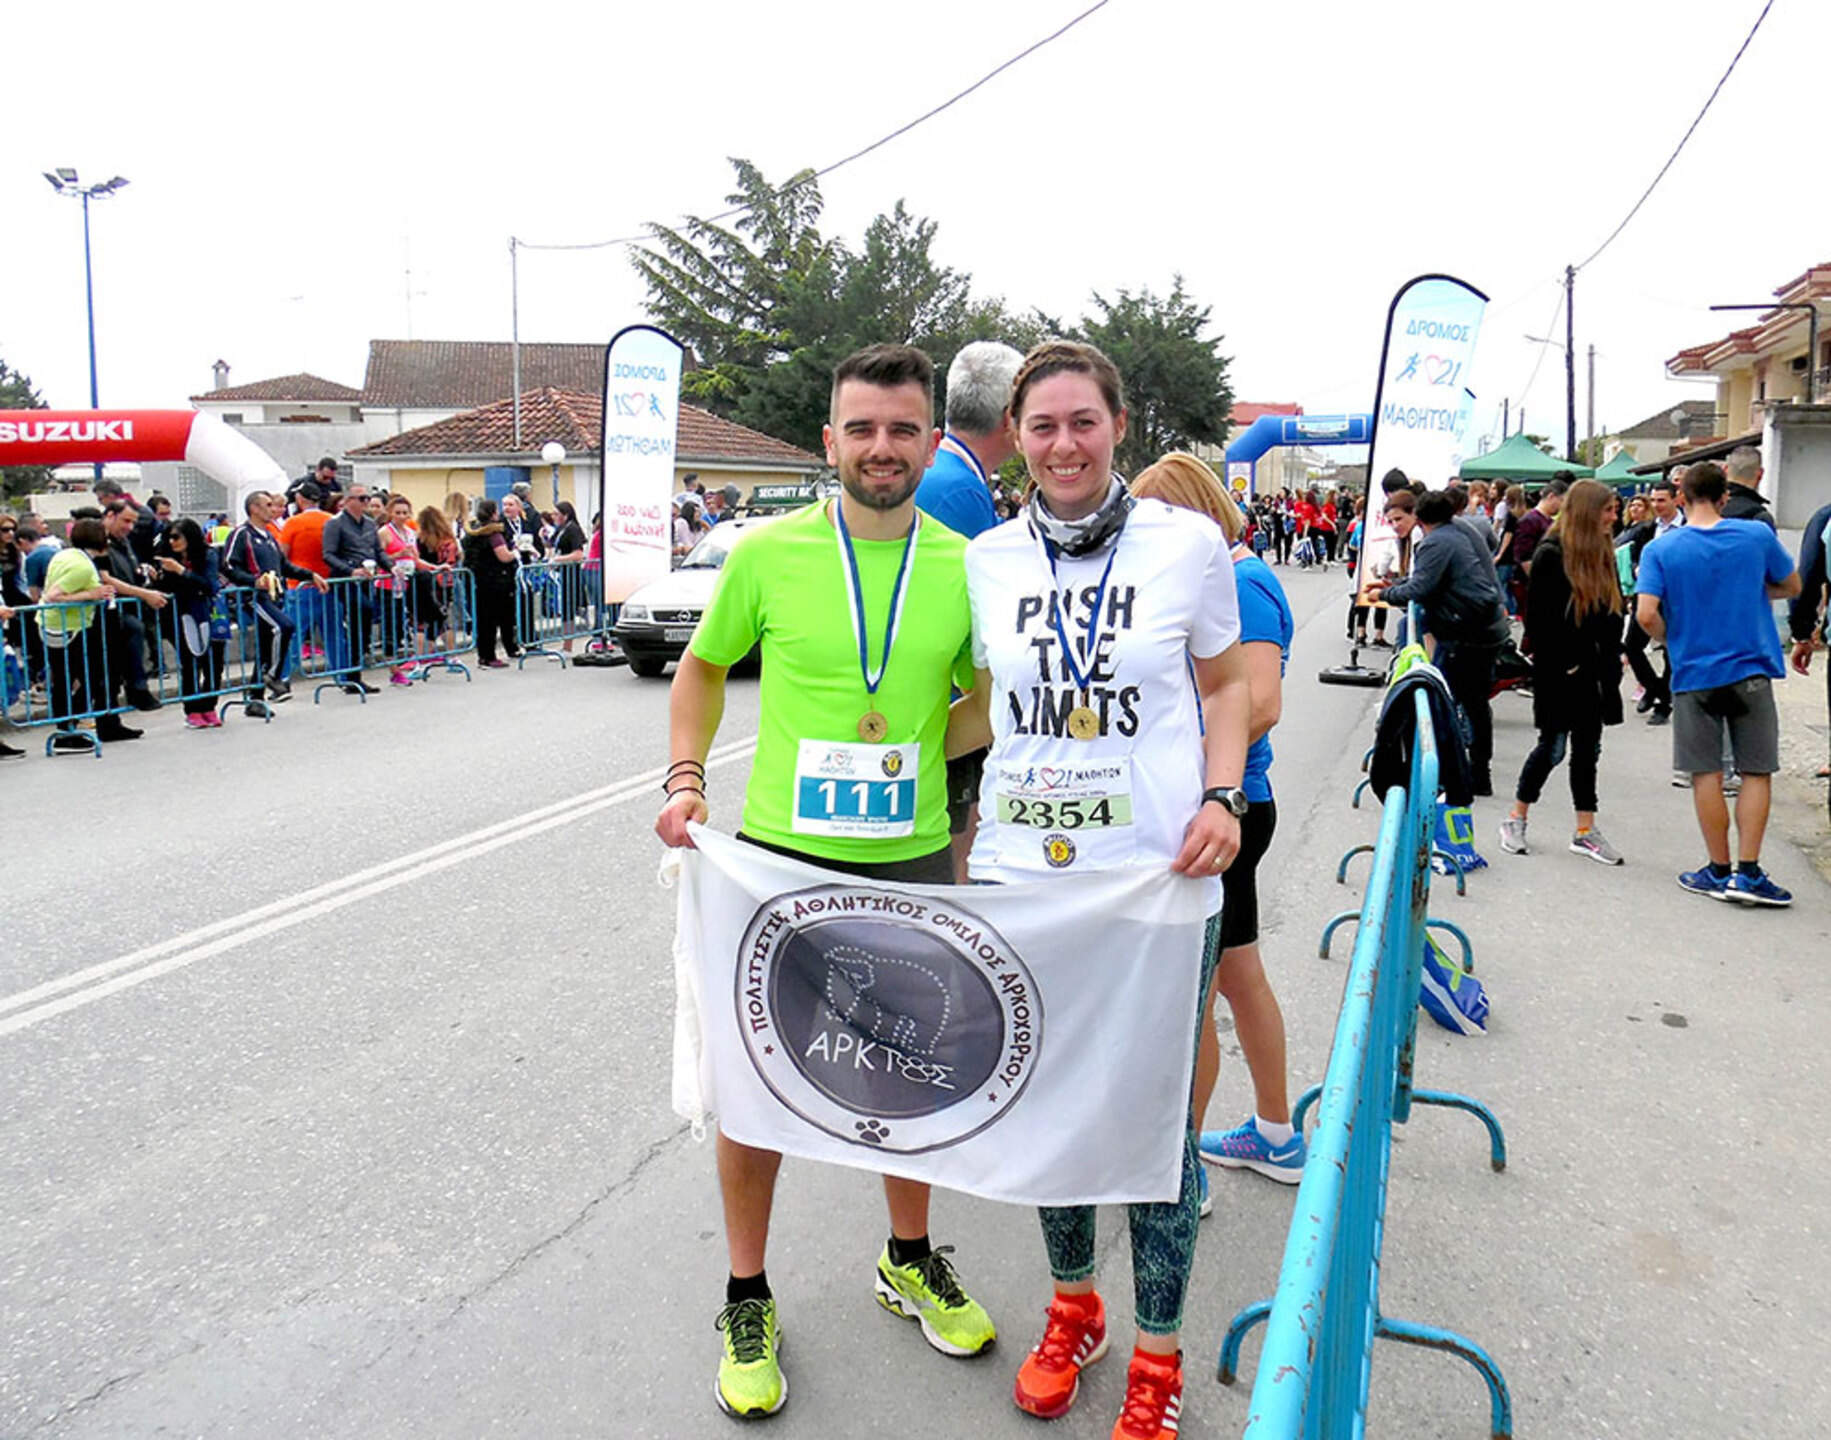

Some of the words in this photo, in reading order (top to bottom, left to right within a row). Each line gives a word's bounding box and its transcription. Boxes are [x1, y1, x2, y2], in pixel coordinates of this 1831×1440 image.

[1406, 319, 1470, 342] ΔΡΟΜΟΣ
[0, 420, 133, 442] SUZUKI
[1382, 402, 1457, 432] ΜΑΘΗΤΩΝ
[1016, 585, 1136, 634] PUSH
[1008, 686, 1142, 738] LIMTS
[817, 780, 900, 816] 111
[1008, 798, 1114, 830] 2354
[793, 896, 928, 920] ΑΘΛΗΤΙΚΟΣ
[931, 913, 1006, 970] ΟΜΙΛΟΣ
